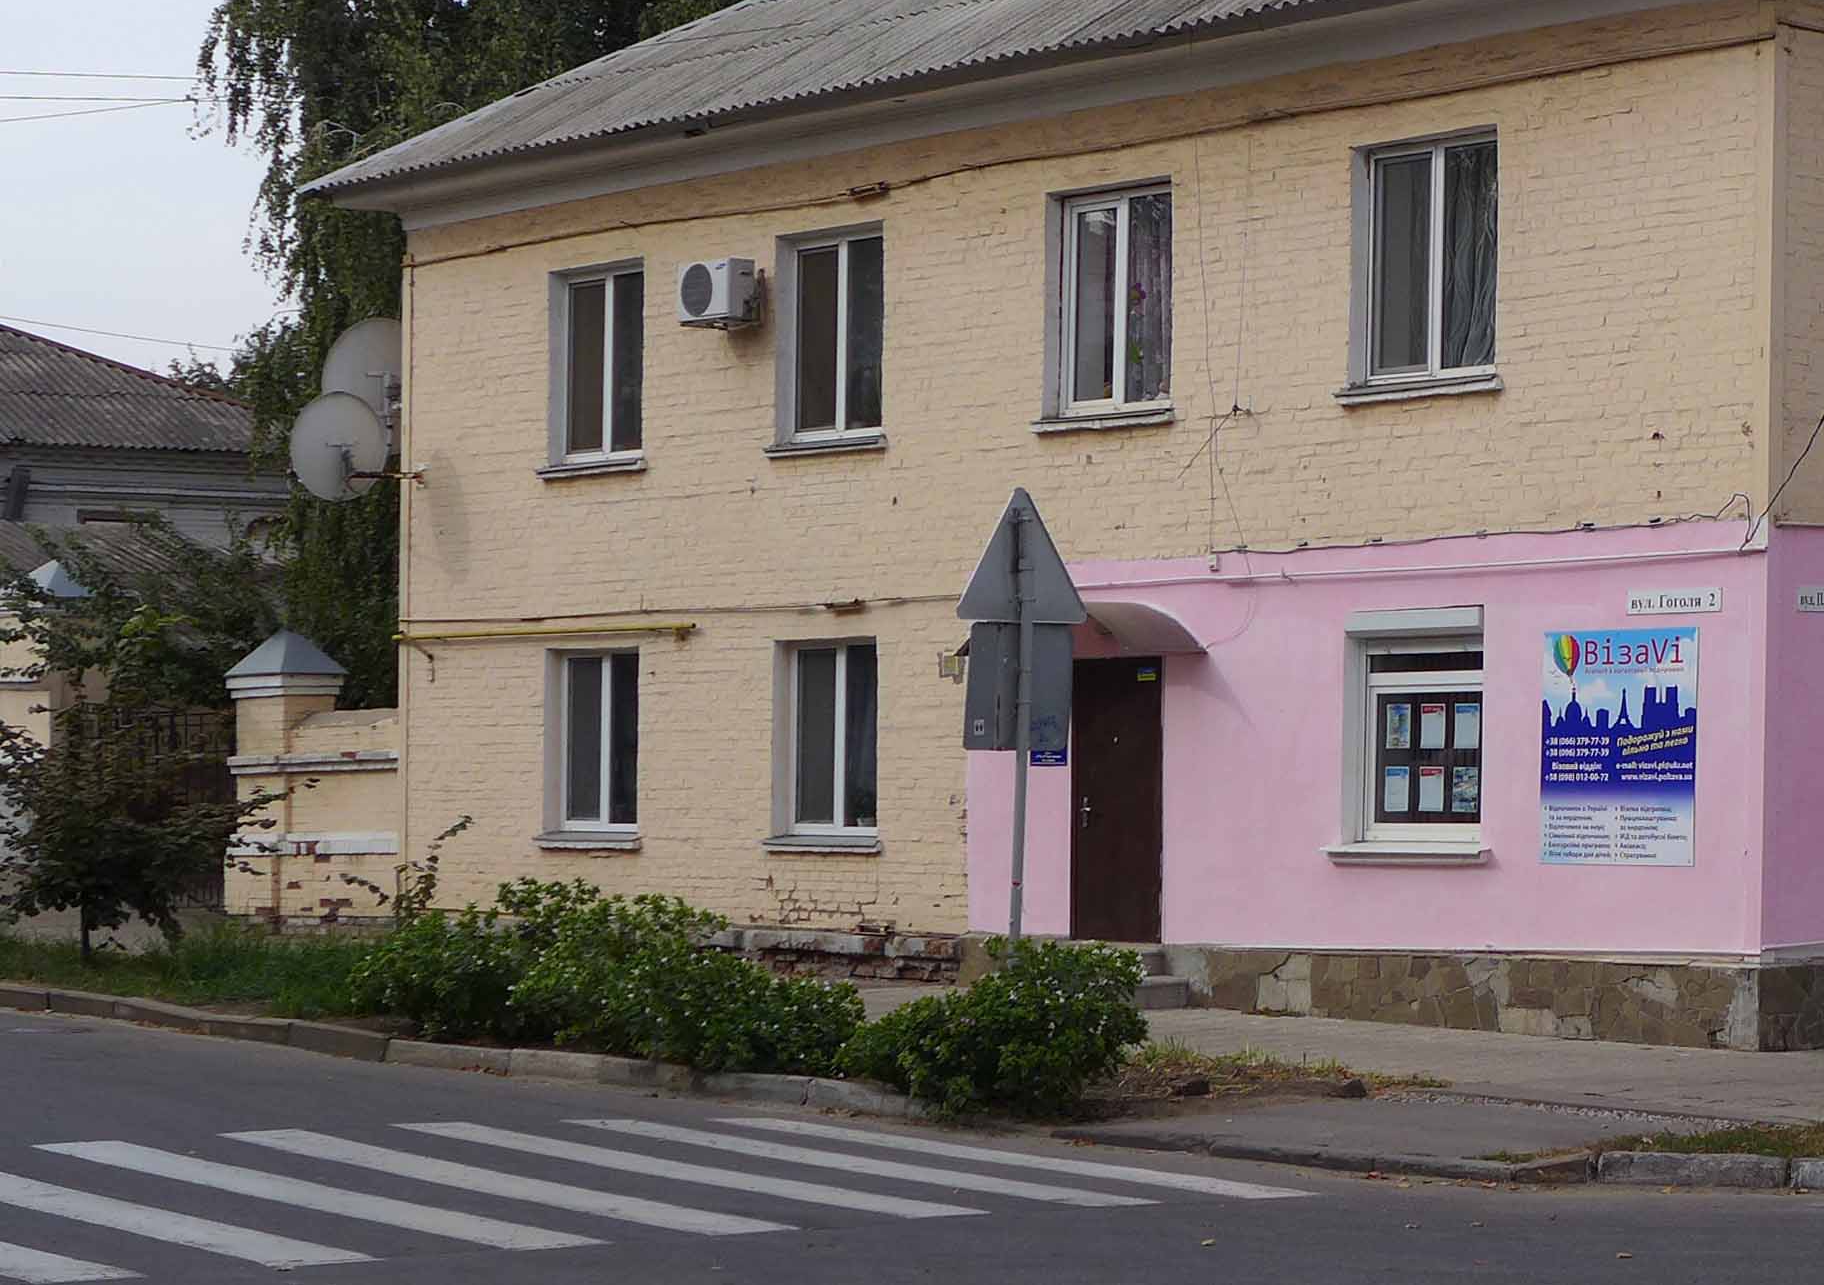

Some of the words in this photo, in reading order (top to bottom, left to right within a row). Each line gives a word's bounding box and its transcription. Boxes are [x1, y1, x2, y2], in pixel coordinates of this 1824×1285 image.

[1631, 599, 1655, 611] вул.
[1660, 594, 1701, 608] Гоголя
[1709, 593, 1715, 607] 2
